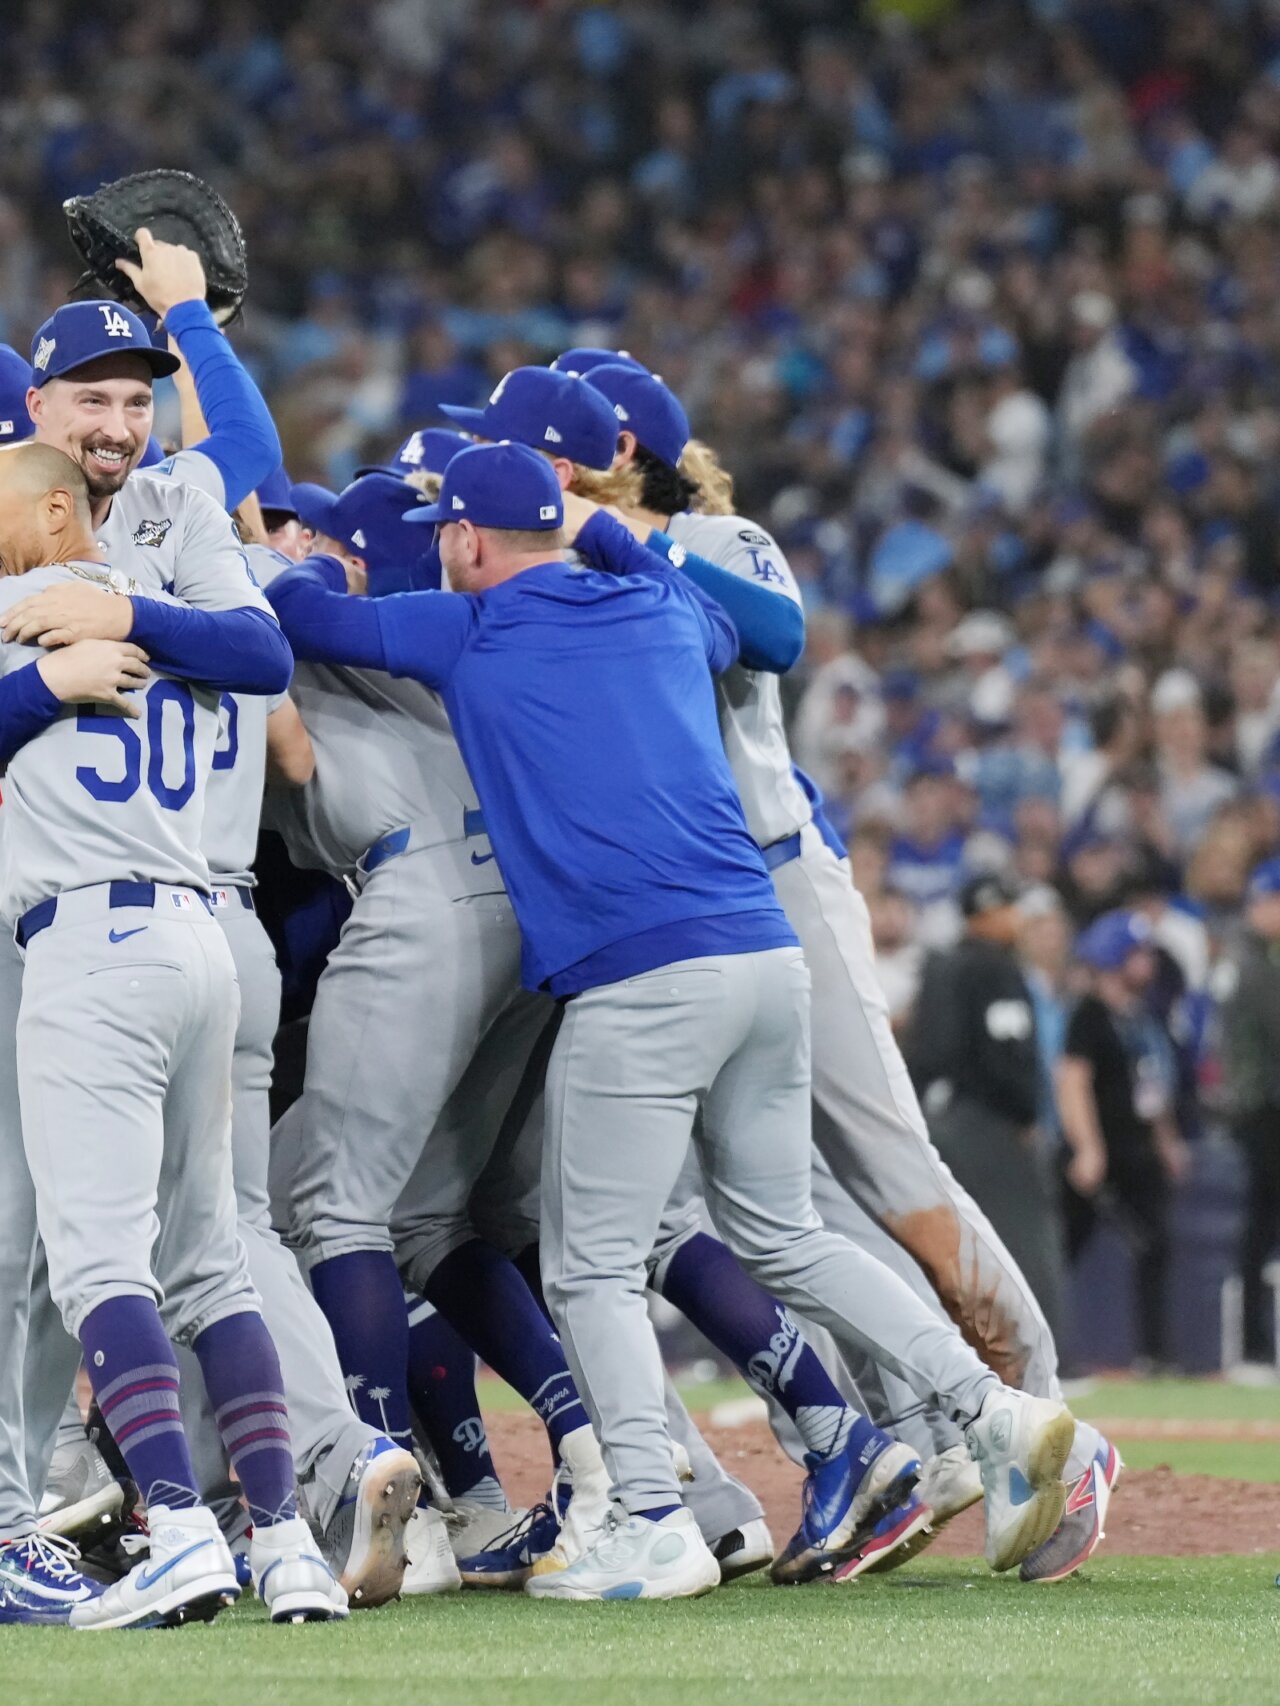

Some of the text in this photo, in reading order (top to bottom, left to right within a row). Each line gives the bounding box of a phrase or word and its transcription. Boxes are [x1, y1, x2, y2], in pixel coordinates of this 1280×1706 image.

[98, 305, 133, 338] LA
[745, 548, 789, 589] LA
[75, 678, 197, 812] 50
